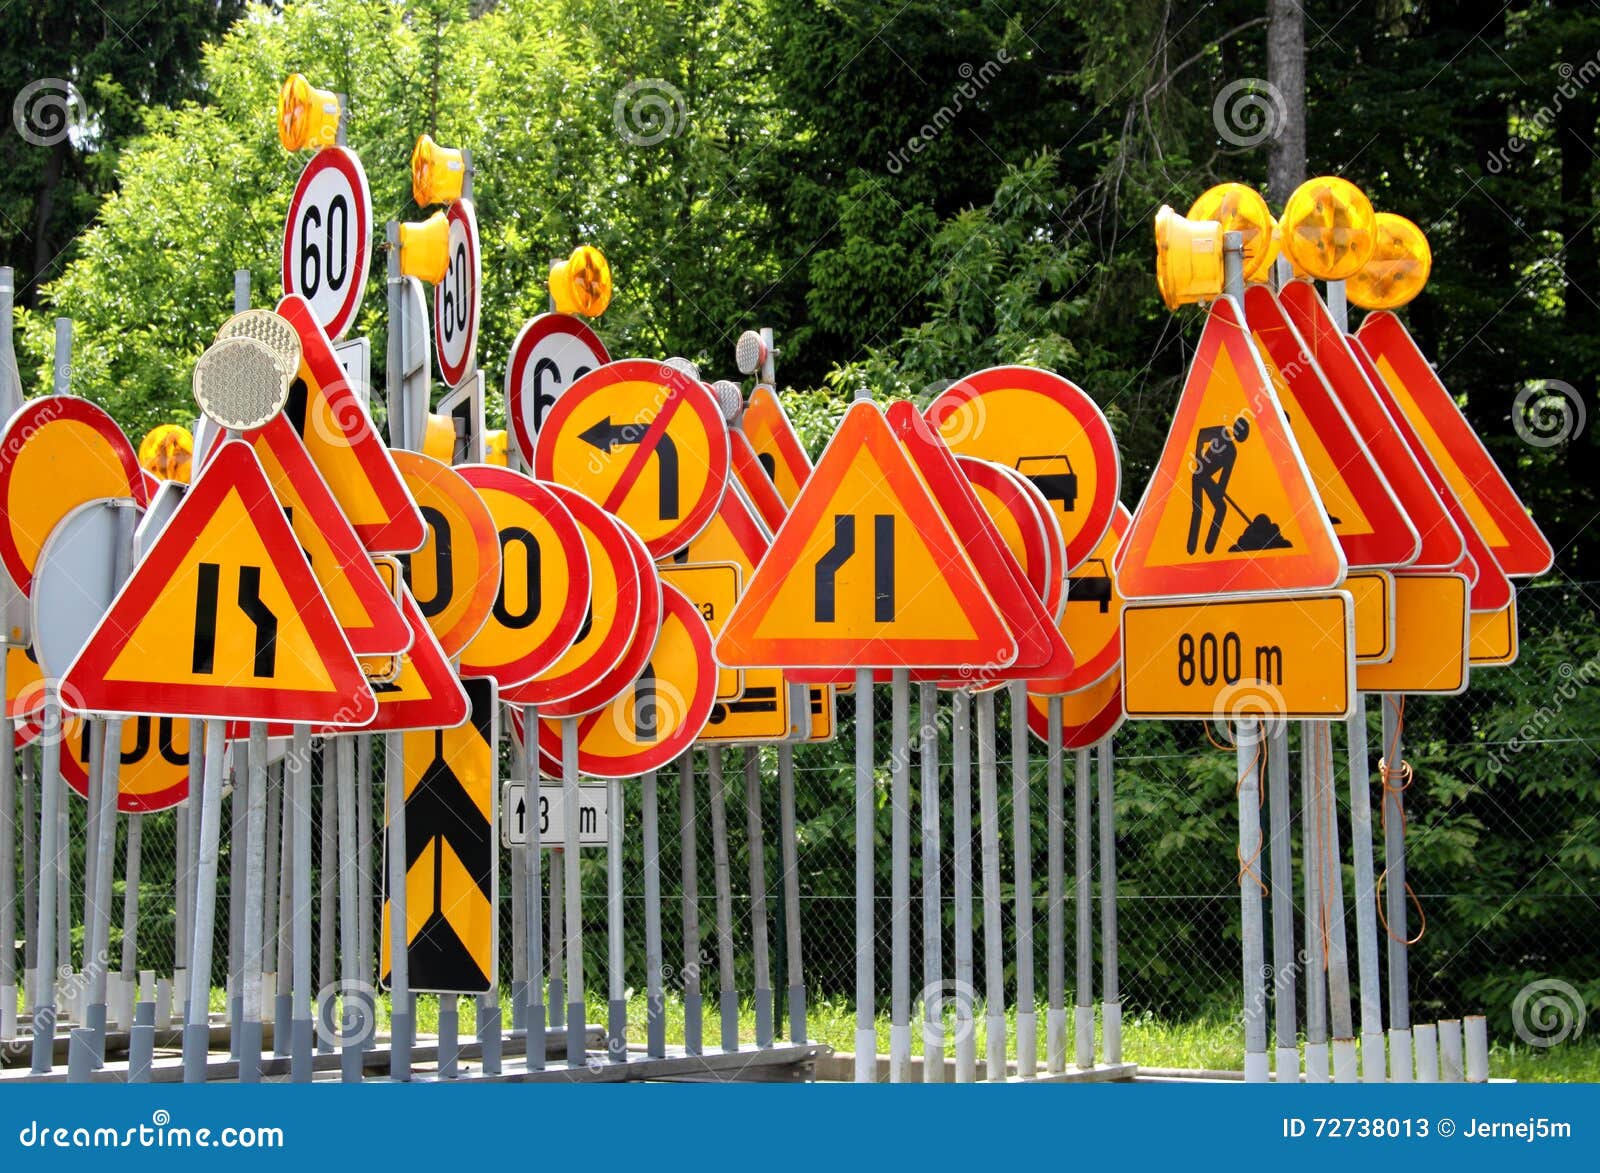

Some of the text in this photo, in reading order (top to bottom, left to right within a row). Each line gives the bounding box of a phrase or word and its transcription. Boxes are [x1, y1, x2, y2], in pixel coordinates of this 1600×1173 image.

[301, 194, 348, 300] 60
[444, 242, 467, 342] 60
[1178, 631, 1283, 686] 800 m
[579, 806, 597, 834] m
